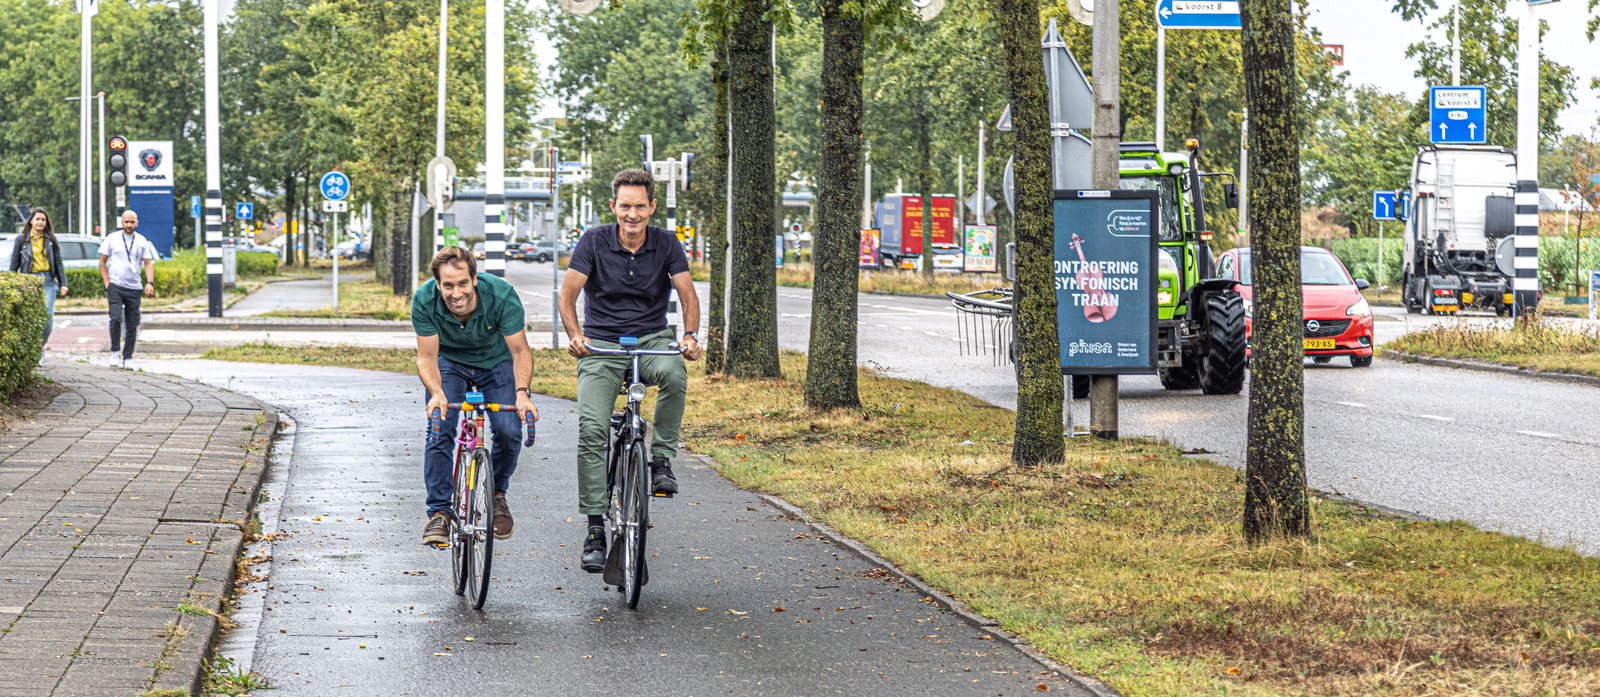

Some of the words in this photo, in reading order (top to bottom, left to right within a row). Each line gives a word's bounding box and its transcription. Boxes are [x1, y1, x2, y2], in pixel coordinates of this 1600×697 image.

[1054, 261, 1139, 274] ONTROERING
[1055, 277, 1138, 290] SYMFONISCH
[1072, 293, 1119, 306] TRAAN
[1069, 338, 1112, 357] phion
[1304, 340, 1332, 348] -793-XS
